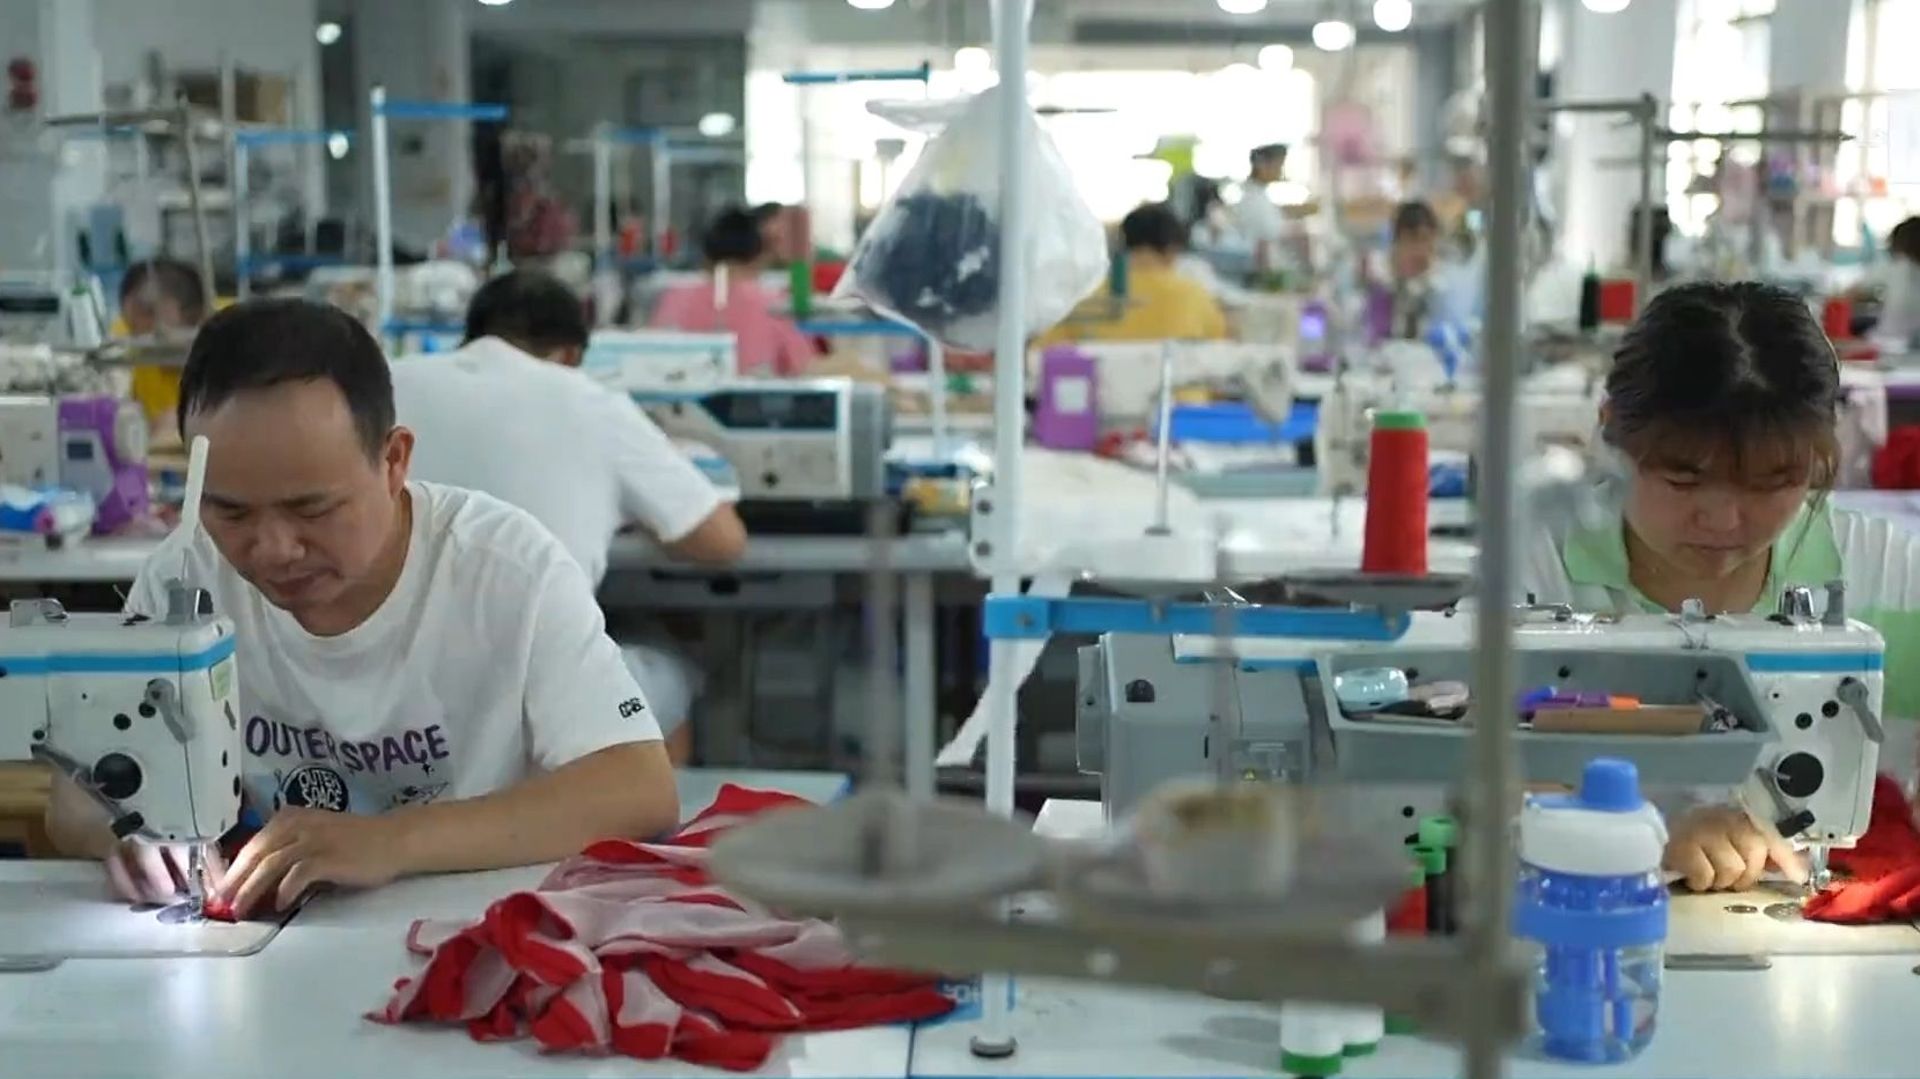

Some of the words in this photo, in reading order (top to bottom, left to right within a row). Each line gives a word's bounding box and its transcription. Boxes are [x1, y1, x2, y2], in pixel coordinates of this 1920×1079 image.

[245, 716, 341, 764] OUTER
[339, 724, 449, 774] SPACE
[298, 768, 342, 791] OUTER
[301, 786, 342, 811] SPACE
